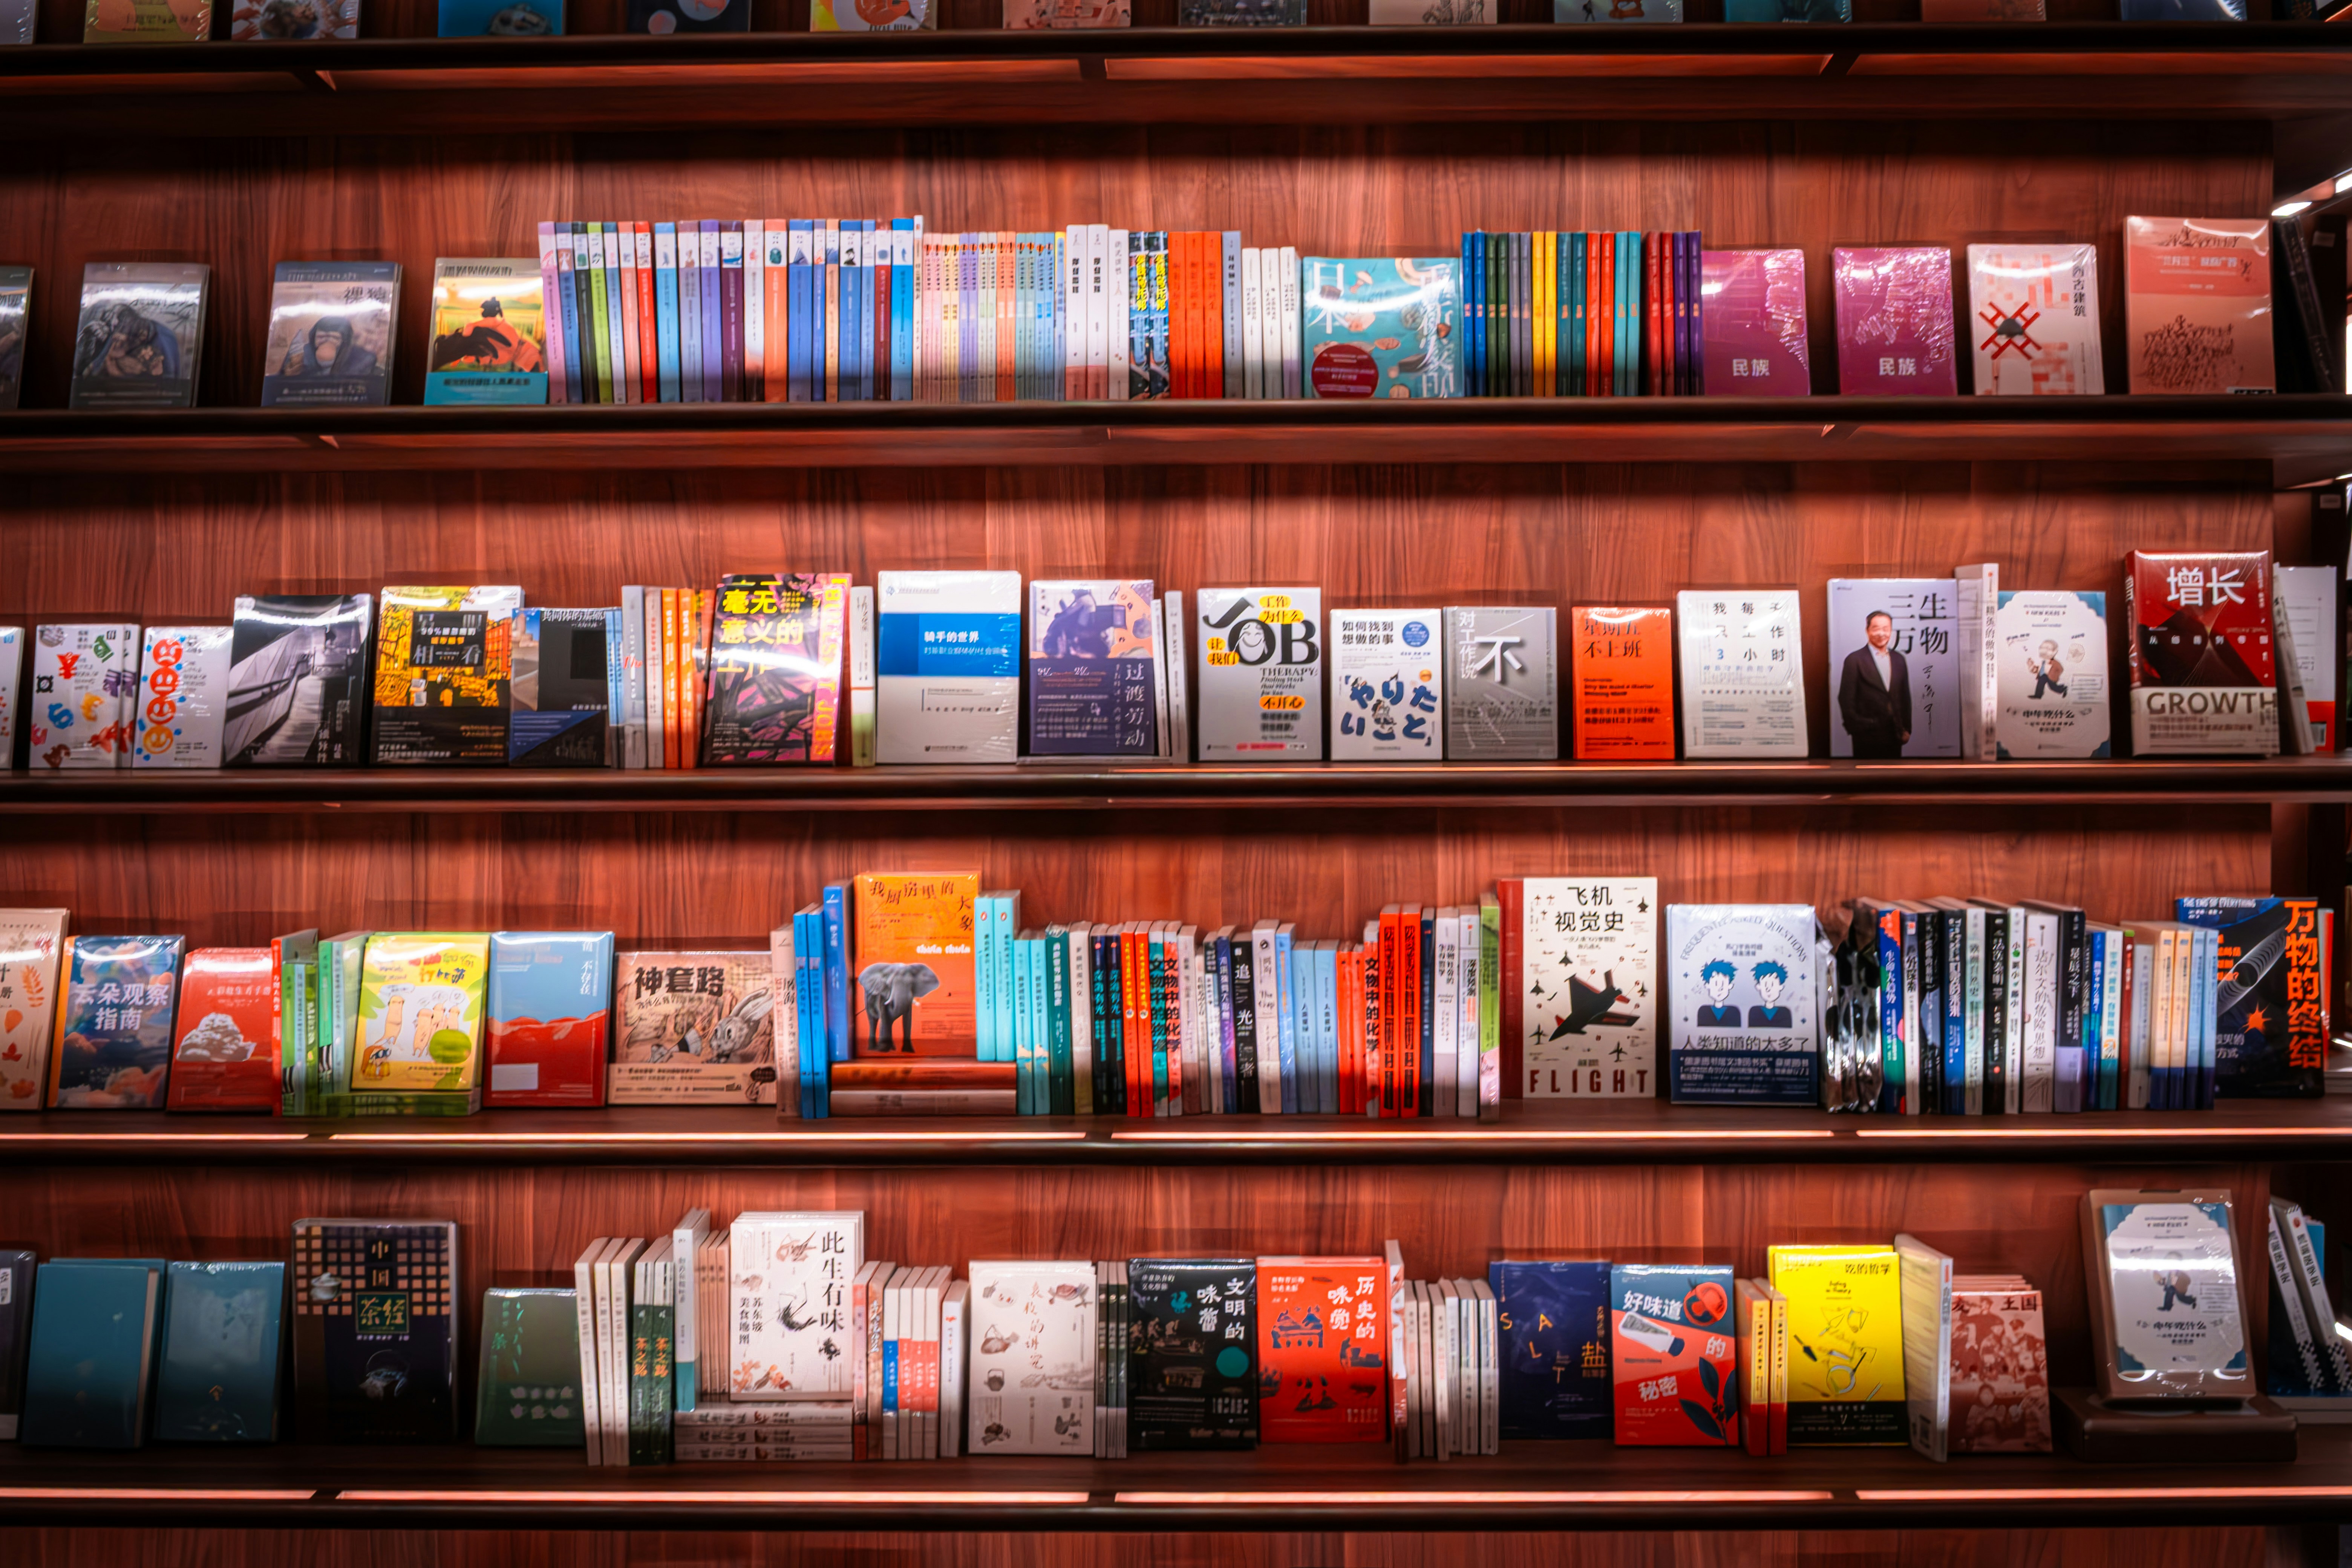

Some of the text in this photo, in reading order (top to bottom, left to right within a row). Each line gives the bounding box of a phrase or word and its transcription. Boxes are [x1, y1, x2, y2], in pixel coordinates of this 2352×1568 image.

[1733, 358, 1770, 377] 民族
[1879, 357, 1917, 376] 民族
[2167, 567, 2245, 606] 增长
[723, 589, 778, 614] 毫无
[1888, 593, 1956, 621] 三生
[720, 619, 804, 645] 意义的
[924, 631, 979, 643] 骑手的世界
[1202, 597, 1319, 666] JOB
[1342, 620, 1394, 632] 如何找到
[1342, 633, 1394, 645] 想做的事
[1584, 640, 1642, 658] 不上班
[1892, 626, 1949, 655] 万物
[1473, 635, 1523, 683] 不
[2146, 692, 2277, 715] GROWTH
[1567, 885, 1612, 906] 飞机
[1555, 911, 1625, 933] 视觉史
[75, 982, 169, 1007] 云朵观察
[635, 966, 725, 1000] 神套路
[2284, 900, 2322, 1069] 万物的终结
[95, 1008, 143, 1031] 指南
[1681, 1035, 1809, 1052] 人类知道的太多了
[1530, 1069, 1649, 1093] FLIGHT
[820, 1231, 845, 1333] 此生有味
[1224, 1277, 1245, 1340] 文明的
[1328, 1285, 1354, 1330] 味觉
[1355, 1276, 1377, 1339] 历史的
[1623, 1289, 1684, 1321] 好味道
[2000, 1295, 2037, 1312] 王国
[1581, 1341, 1607, 1367] 盐
[1706, 1336, 1726, 1358] 的
[1638, 1375, 1678, 1402] 秘密
